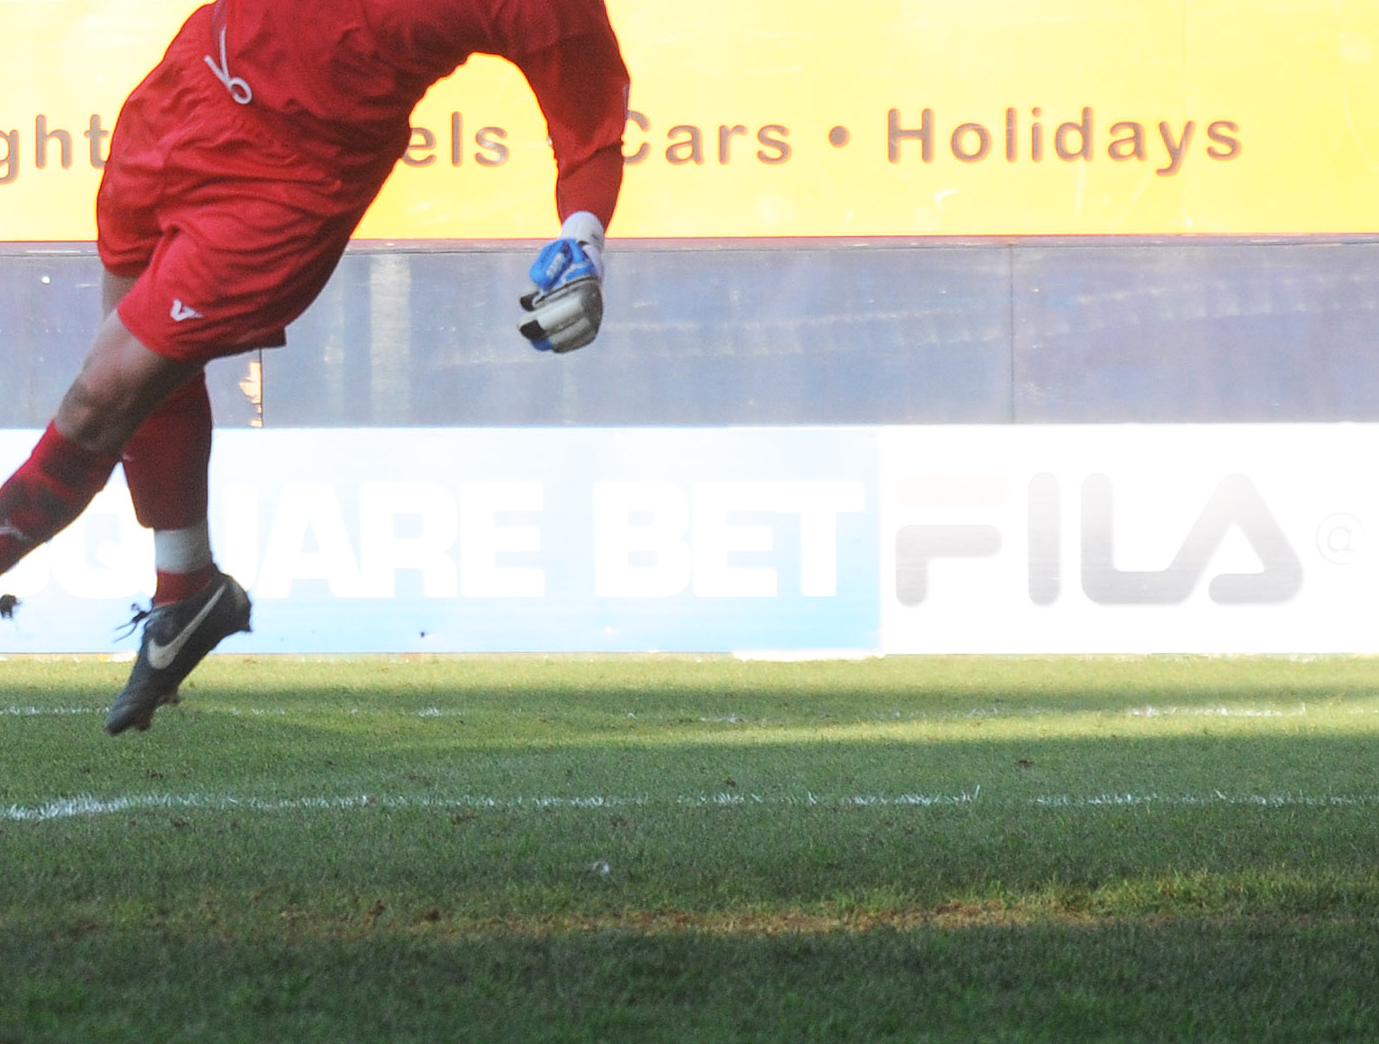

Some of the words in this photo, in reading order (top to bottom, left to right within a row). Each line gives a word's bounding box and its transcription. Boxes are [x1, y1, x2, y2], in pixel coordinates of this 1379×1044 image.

[623, 110, 792, 166] Cars
[887, 106, 1243, 177] Holidays
[593, 481, 864, 597] BET
[896, 471, 1303, 607] FILA
